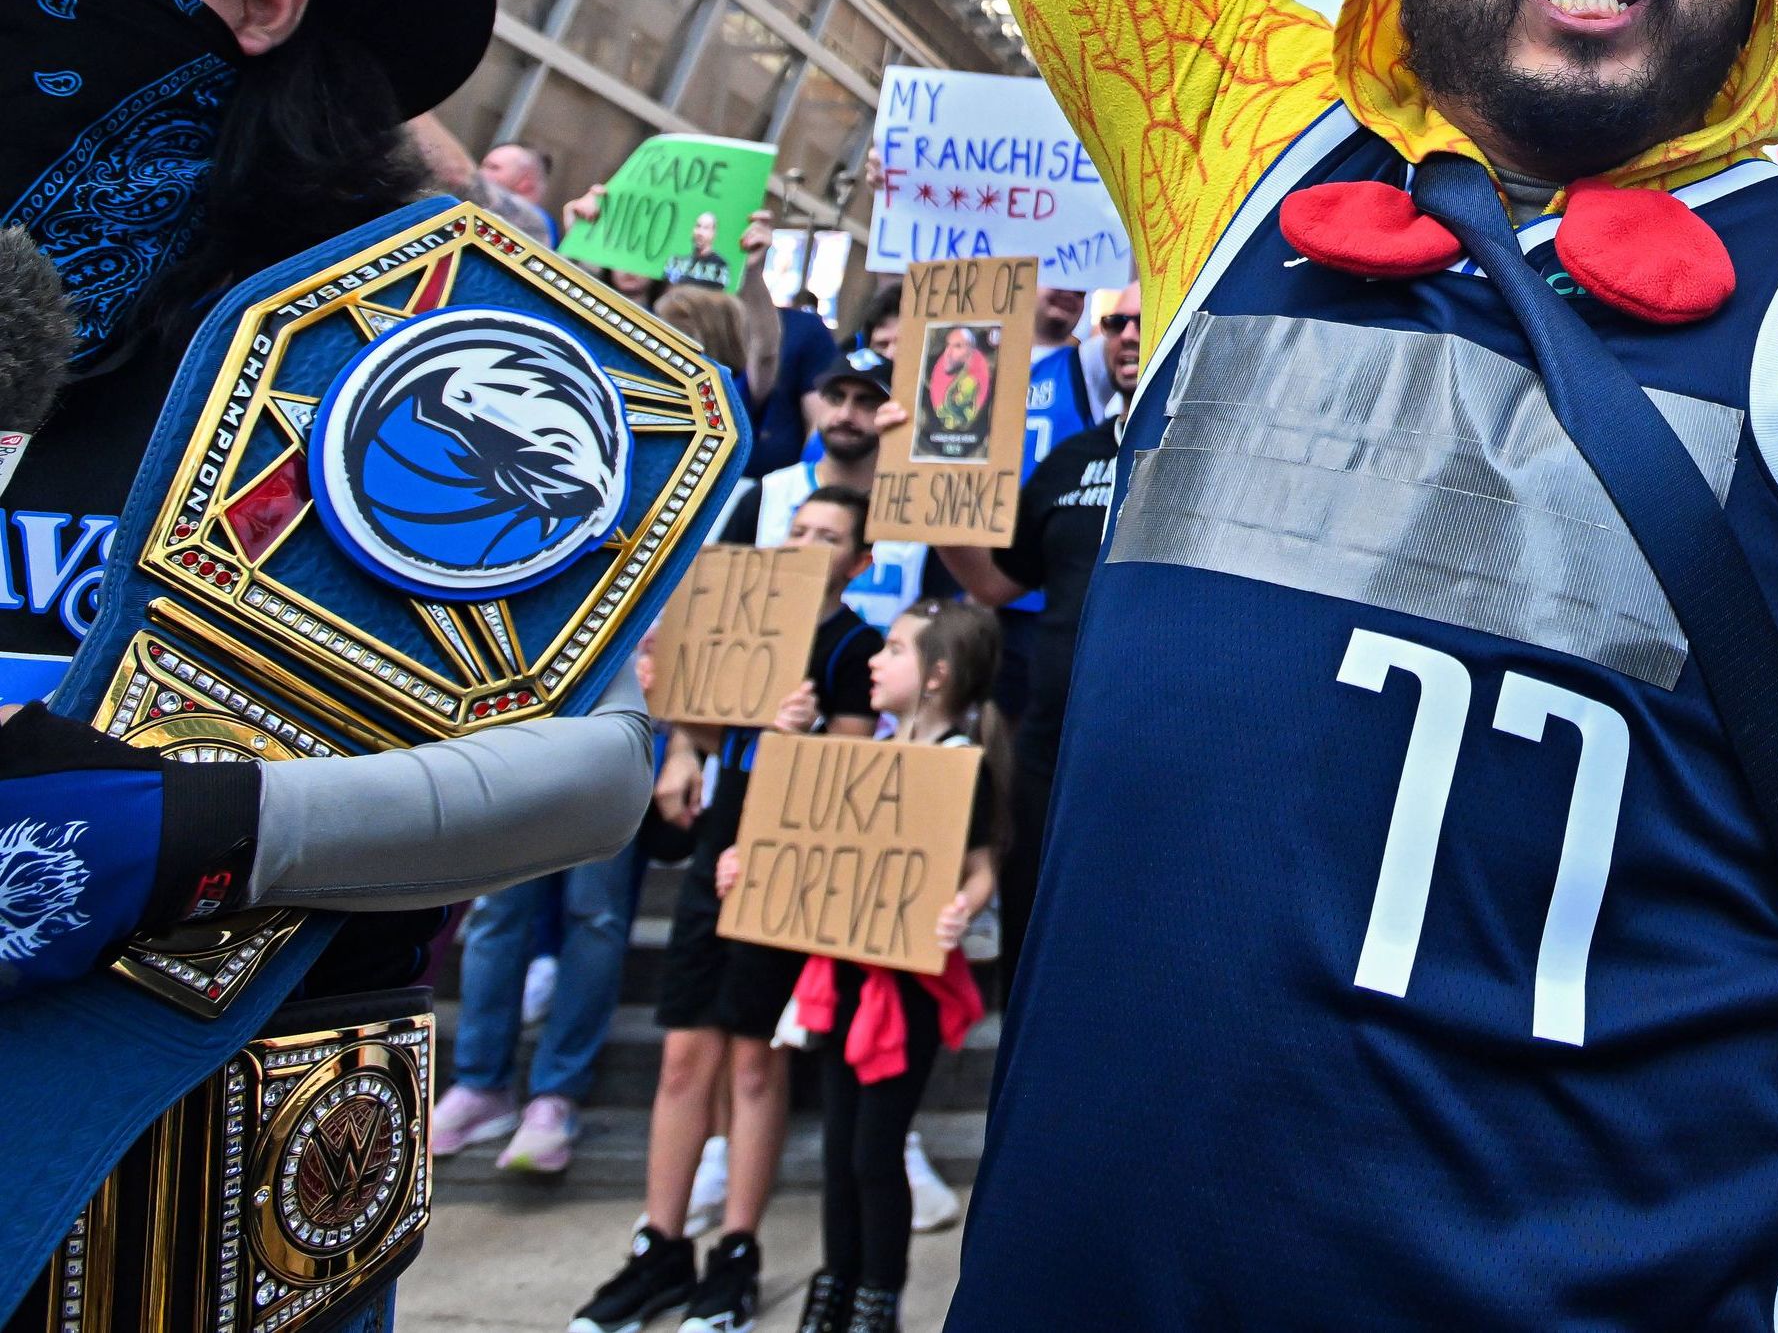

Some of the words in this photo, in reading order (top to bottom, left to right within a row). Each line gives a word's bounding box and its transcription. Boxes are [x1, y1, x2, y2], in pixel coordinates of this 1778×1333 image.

[888, 79, 944, 123] MY
[627, 144, 729, 199] TRADE
[884, 126, 1100, 183] FRANCHISE
[584, 192, 679, 261] NICO
[877, 217, 992, 262] LUKA
[276, 233, 445, 317] UNIVERSAL
[910, 263, 979, 318] YEAR
[992, 262, 1033, 315] OF
[186, 333, 272, 513] CHAMPION
[872, 471, 920, 524] THE
[925, 469, 1015, 533] SNAKE
[684, 546, 799, 637] FIRE
[665, 641, 775, 718] NICO
[779, 740, 904, 835] LUKA
[1336, 627, 1631, 1047] 77
[734, 839, 929, 957] FOREVER
